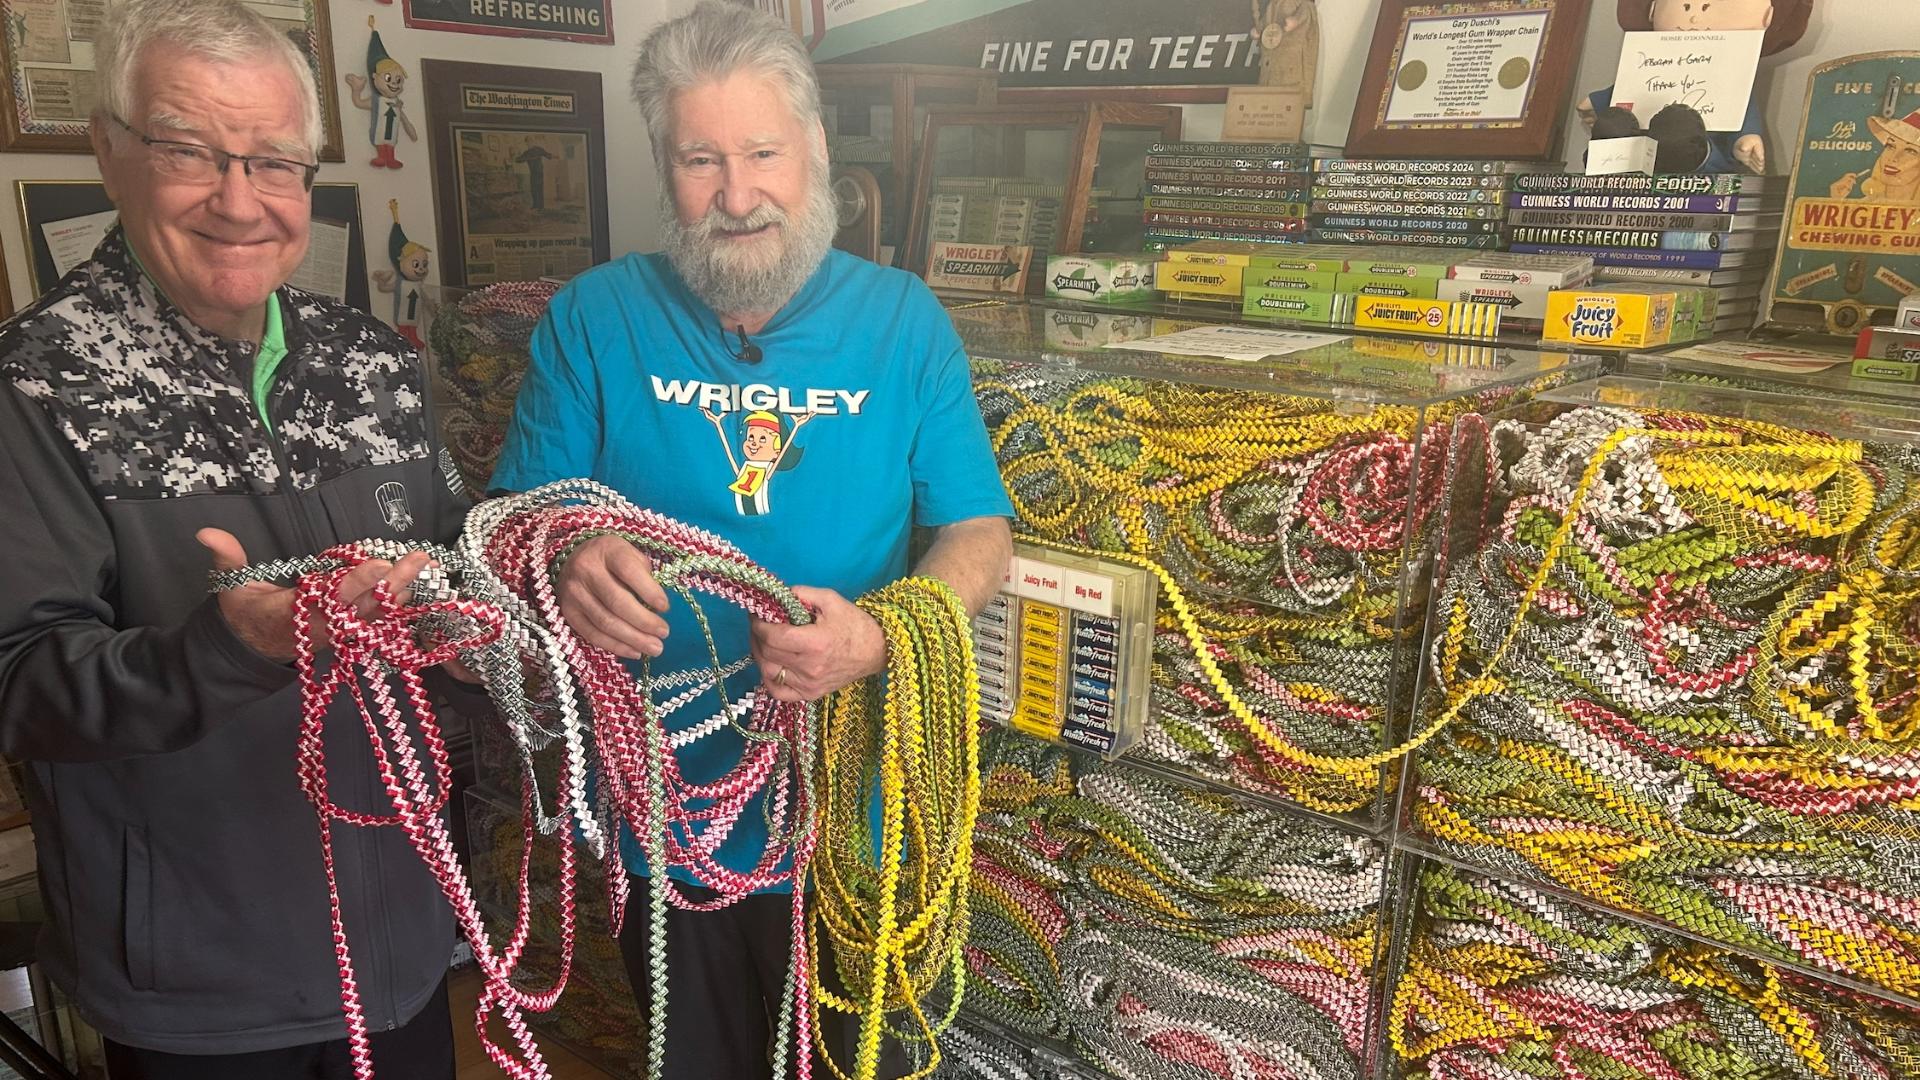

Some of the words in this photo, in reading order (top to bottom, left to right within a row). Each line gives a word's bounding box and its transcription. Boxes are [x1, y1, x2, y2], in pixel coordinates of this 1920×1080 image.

[470, 0, 600, 26] REFRESHING
[1452, 20, 1468, 29] Gary
[1412, 32, 1438, 41] World's
[1439, 31, 1467, 42] Longest
[1468, 30, 1485, 38] Gum
[1486, 28, 1517, 38] Wrapper
[1518, 26, 1539, 35] Chain
[980, 41, 1053, 73] FINE
[1064, 38, 1134, 71] FOR
[1834, 82, 1873, 94] FIVE
[469, 91, 486, 104] The
[488, 92, 542, 108] Washington
[544, 96, 570, 109] Times
[1153, 144, 1195, 152] GUINNESS
[1196, 145, 1225, 153] WORLD
[1228, 145, 1269, 154] RECORDS
[1270, 146, 1291, 155] 2013
[1809, 140, 1873, 152] DELICIOUS
[1150, 158, 1191, 167] GUINNESS
[1191, 158, 1223, 168] WORLD
[1224, 160, 1265, 168] RECORDS
[1330, 162, 1372, 171] GUINNESS
[1374, 162, 1406, 171] WORLD
[1408, 163, 1450, 172] RECORDS
[1452, 163, 1474, 172] 2024
[1148, 172, 1190, 181] GUINNESS
[1191, 172, 1221, 182] WORLD
[1224, 174, 1263, 184] RECORDS
[1266, 176, 1286, 184] 2011
[1330, 176, 1371, 184] GUINNESS
[1372, 176, 1404, 185] WORLD
[1407, 176, 1448, 185] RECORDS
[1450, 177, 1472, 186] 2023
[1522, 176, 1568, 188] GUINNESS
[1570, 177, 1604, 188] WORLD
[1607, 177, 1652, 189] RECORDS
[1656, 178, 1706, 192] 2002
[1152, 184, 1192, 194] GUINNESS
[1193, 186, 1223, 195] WORLD
[1224, 188, 1263, 198] RECORDS
[1264, 189, 1287, 198] 2010
[1327, 190, 1368, 198] GUINNESS
[1370, 190, 1401, 199] WORLD
[1404, 191, 1445, 200] RECORDS
[1446, 192, 1468, 200] 2022
[1151, 200, 1190, 208] GUINNESS
[1191, 201, 1221, 210] WORLD
[1223, 203, 1261, 212] RECORDS
[1262, 205, 1285, 214] 2009
[1327, 203, 1369, 212] GUINNESS
[1370, 204, 1401, 213] WORLD
[1404, 205, 1446, 214] RECORDS
[1447, 206, 1467, 216] 2021
[1521, 196, 1570, 208] GUINNESS
[1572, 196, 1610, 208] WORLD
[1612, 197, 1660, 209] RECORDS
[1663, 198, 1690, 209] 2001
[1152, 214, 1188, 223] GUINNESS
[1192, 216, 1221, 224] WORLD
[1222, 218, 1261, 227] RECORDS
[1324, 218, 1366, 226] GUINNESS
[1368, 218, 1399, 227] WORLD
[1401, 219, 1443, 228] RECORDS
[1446, 221, 1468, 230] 2020
[1521, 212, 1569, 224] GUINNESS
[1576, 213, 1613, 226] WORLD
[1616, 215, 1665, 228] RECORDS
[1668, 216, 1694, 228] 2000
[529, 239, 538, 249] up
[555, 237, 577, 247] record
[1149, 228, 1189, 237] GUINNESS
[1192, 230, 1221, 239] WORLD
[1223, 232, 1261, 242] RECORDS
[1265, 234, 1287, 244] 2007
[1322, 232, 1365, 240] GUINNESS
[1367, 232, 1400, 242] WORLD
[1402, 234, 1444, 244] RECORDS
[1446, 236, 1467, 244] 2019
[1518, 228, 1584, 244] GUINNESS
[1594, 230, 1659, 247] RECORDS
[1800, 231, 1882, 246] CHEWING
[946, 247, 1008, 261] WRIGLEY'S
[1610, 252, 1632, 260] WORLD
[1633, 253, 1662, 261] RECORDS
[946, 262, 1009, 275] SPEARMINT
[1628, 268, 1657, 277] RECORDS
[1056, 276, 1097, 292] SPEARMINT
[1178, 274, 1198, 282] JUICY
[1200, 276, 1220, 284] FRUIT
[1269, 281, 1306, 289] DOUBLEMINT
[1364, 288, 1405, 296] DOUBLEMINT
[1475, 288, 1512, 297] WRIGLEY'S
[1260, 300, 1306, 310] DOUBLEMINT
[1373, 308, 1395, 319] JUICY
[1396, 310, 1418, 321] FRUIT
[1571, 304, 1616, 322] Juicy
[1572, 320, 1614, 338] Fruit
[650, 374, 871, 415] WRIGLEY
[738, 470, 758, 492] 1
[1024, 574, 1041, 587] Juicy
[1042, 578, 1058, 590] Fruit
[1075, 586, 1086, 598] Big
[1088, 588, 1102, 600] Red
[1073, 628, 1112, 644] Winterfresh
[1072, 646, 1110, 662] Winterfresh
[1070, 664, 1109, 679] Winterfresh
[1068, 697, 1107, 714] Winterfresh
[1068, 713, 1106, 730] Winterfresh
[1063, 729, 1101, 746] Winterfresh
